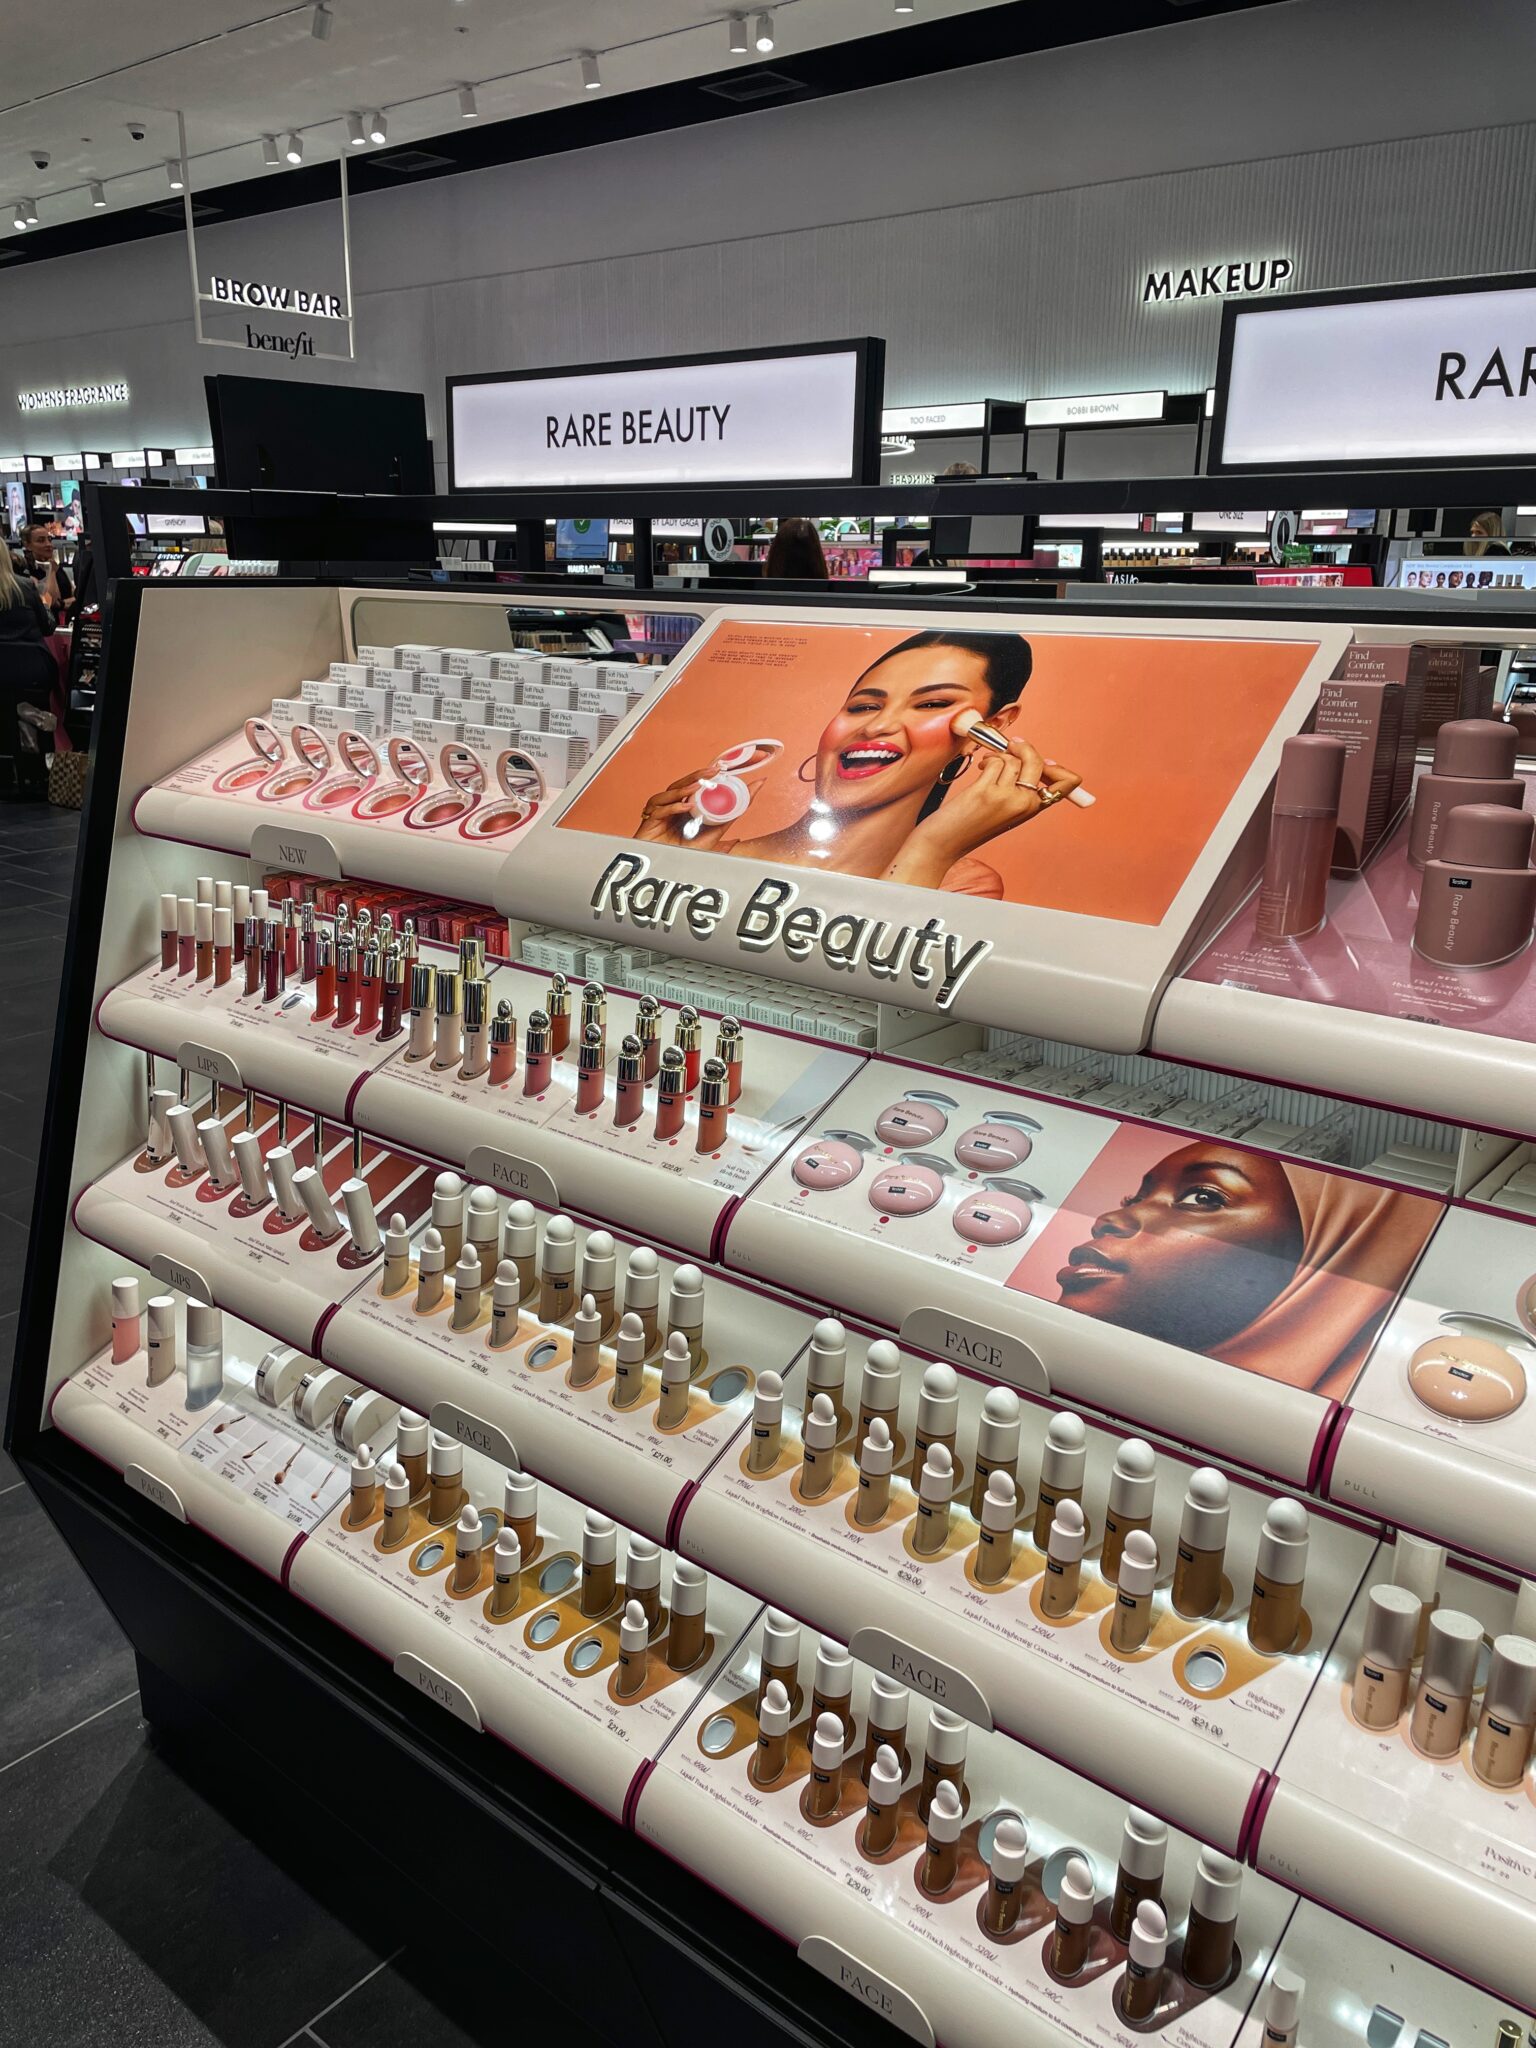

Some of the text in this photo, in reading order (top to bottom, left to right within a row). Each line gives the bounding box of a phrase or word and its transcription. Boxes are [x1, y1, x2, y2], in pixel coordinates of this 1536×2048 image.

[1145, 257, 1294, 302] MAKEUP
[212, 277, 342, 317] BROW BAR
[246, 324, 316, 360] benefit
[1435, 346, 1536, 401] RAR
[18, 383, 129, 411] WOMENS FRAGRANCE
[910, 415, 946, 424] TOO FACED
[1067, 404, 1119, 415] BOBBI BROWN
[546, 404, 731, 448] RARE BEAUTY
[157, 553, 184, 561] GIVENCHY
[1348, 661, 1384, 670] Comfort
[1350, 651, 1369, 660] Find
[1322, 688, 1342, 697] Find
[1321, 698, 1358, 708] Comfort
[1425, 801, 1441, 854] Rare Beauty
[279, 843, 307, 866] NEW
[1451, 878, 1469, 886] Tester
[590, 852, 728, 934] Rare
[737, 878, 994, 1009] Beauty
[1444, 894, 1463, 951] Rare Beauty
[197, 1055, 220, 1075] LIPS
[905, 1111, 924, 1120] Beauty
[988, 1133, 1009, 1143] Beauty
[492, 1161, 529, 1189] FACE
[170, 1269, 191, 1289] LIPS
[944, 1329, 1004, 1368] FACE
[471, 1362, 488, 1375] £29.00
[1452, 1369, 1469, 1378] Tester
[512, 1384, 524, 1394] Liquid
[523, 1389, 536, 1399] Touch
[455, 1419, 492, 1452] FACE
[652, 1451, 673, 1464] £21.00
[140, 1478, 165, 1504] FACE
[1344, 1479, 1377, 1499] PULL
[725, 1489, 740, 1501] Liquid
[740, 1496, 755, 1507] Touch
[755, 1504, 779, 1519] Weightless
[779, 1515, 806, 1533] Foundation
[788, 1505, 806, 1517] 200C
[685, 1538, 707, 1554] PULL
[434, 1608, 451, 1623] £29.00
[1031, 1624, 1055, 1640] 250W
[474, 1636, 535, 1678] Liquid Touch Brightening Concealer
[963, 1608, 982, 1622] Liquid
[982, 1617, 1001, 1631] Touch
[1001, 1627, 1033, 1648] Brightening
[1033, 1644, 1064, 1664] Concealer
[1069, 1662, 1092, 1678] Hydrating
[1091, 1674, 1111, 1687] medium
[1116, 1686, 1125, 1694] full
[1124, 1690, 1148, 1706] coverage,
[1101, 1660, 1125, 1674] 270N
[890, 1653, 946, 1698] FACE
[418, 1672, 454, 1708] FACE
[649, 1704, 671, 1721] Concealer
[654, 1698, 677, 1716] Brightening
[1177, 1696, 1202, 1712] 280N
[1245, 1700, 1281, 1721] Concealer
[1247, 1691, 1286, 1715] Brightening
[607, 1721, 627, 1738] £21.00
[1191, 1715, 1224, 1737] £21.00
[680, 1769, 696, 1783] Liquid
[694, 1777, 709, 1792] Touch
[709, 1787, 732, 1807] Weightless
[732, 1802, 758, 1824] Foundation
[1269, 1853, 1303, 1877] PULL
[1485, 1846, 1531, 1876] Positive
[847, 1878, 871, 1896] £29.00
[912, 1904, 932, 1919] 500N
[975, 1944, 999, 1962] 520W
[907, 1920, 927, 1937] Liquid
[926, 1930, 944, 1947] Touch
[944, 1941, 974, 1969] Brightening
[975, 1962, 1004, 1986] Concealer
[1008, 1986, 1030, 2005] Hydrating
[1029, 2001, 1049, 2016] medium
[1053, 2015, 1061, 2024] full
[1060, 2020, 1083, 2039] coverage,
[839, 1965, 894, 2015] FACE
[1041, 1987, 1064, 2004] 540C
